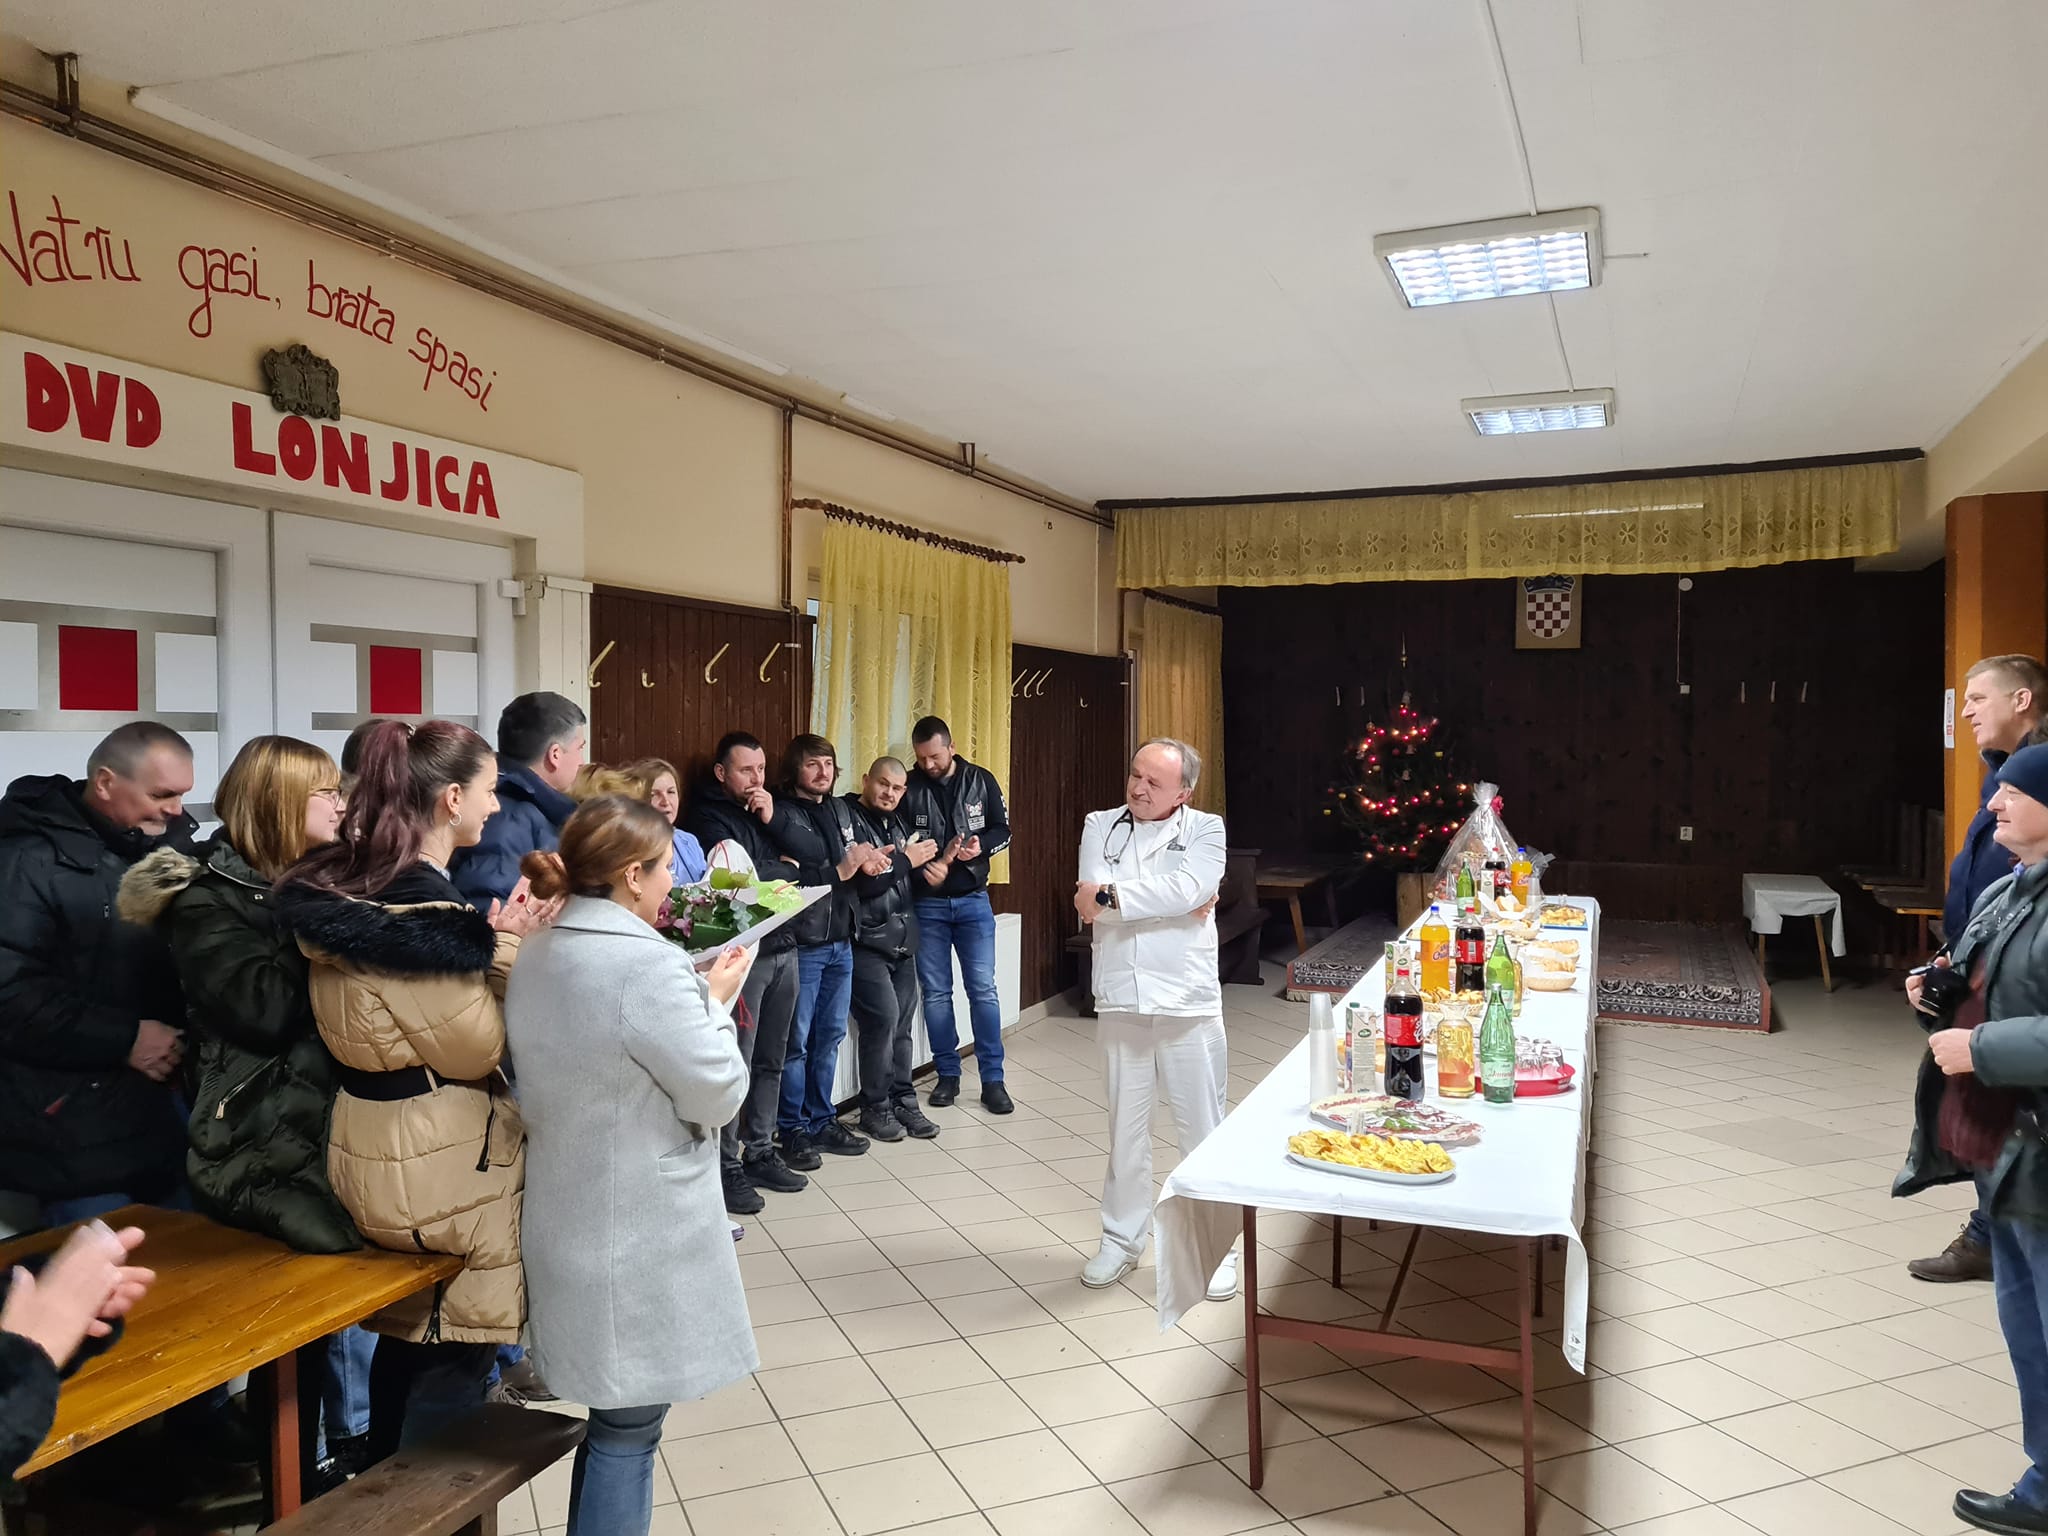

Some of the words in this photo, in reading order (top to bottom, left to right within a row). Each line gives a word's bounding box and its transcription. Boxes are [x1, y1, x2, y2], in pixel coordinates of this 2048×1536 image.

[178, 245, 282, 338] gasi,
[306, 259, 396, 344] brata
[407, 327, 498, 412] spasi
[23, 351, 162, 449] DVD
[231, 401, 500, 520] LONJICA
